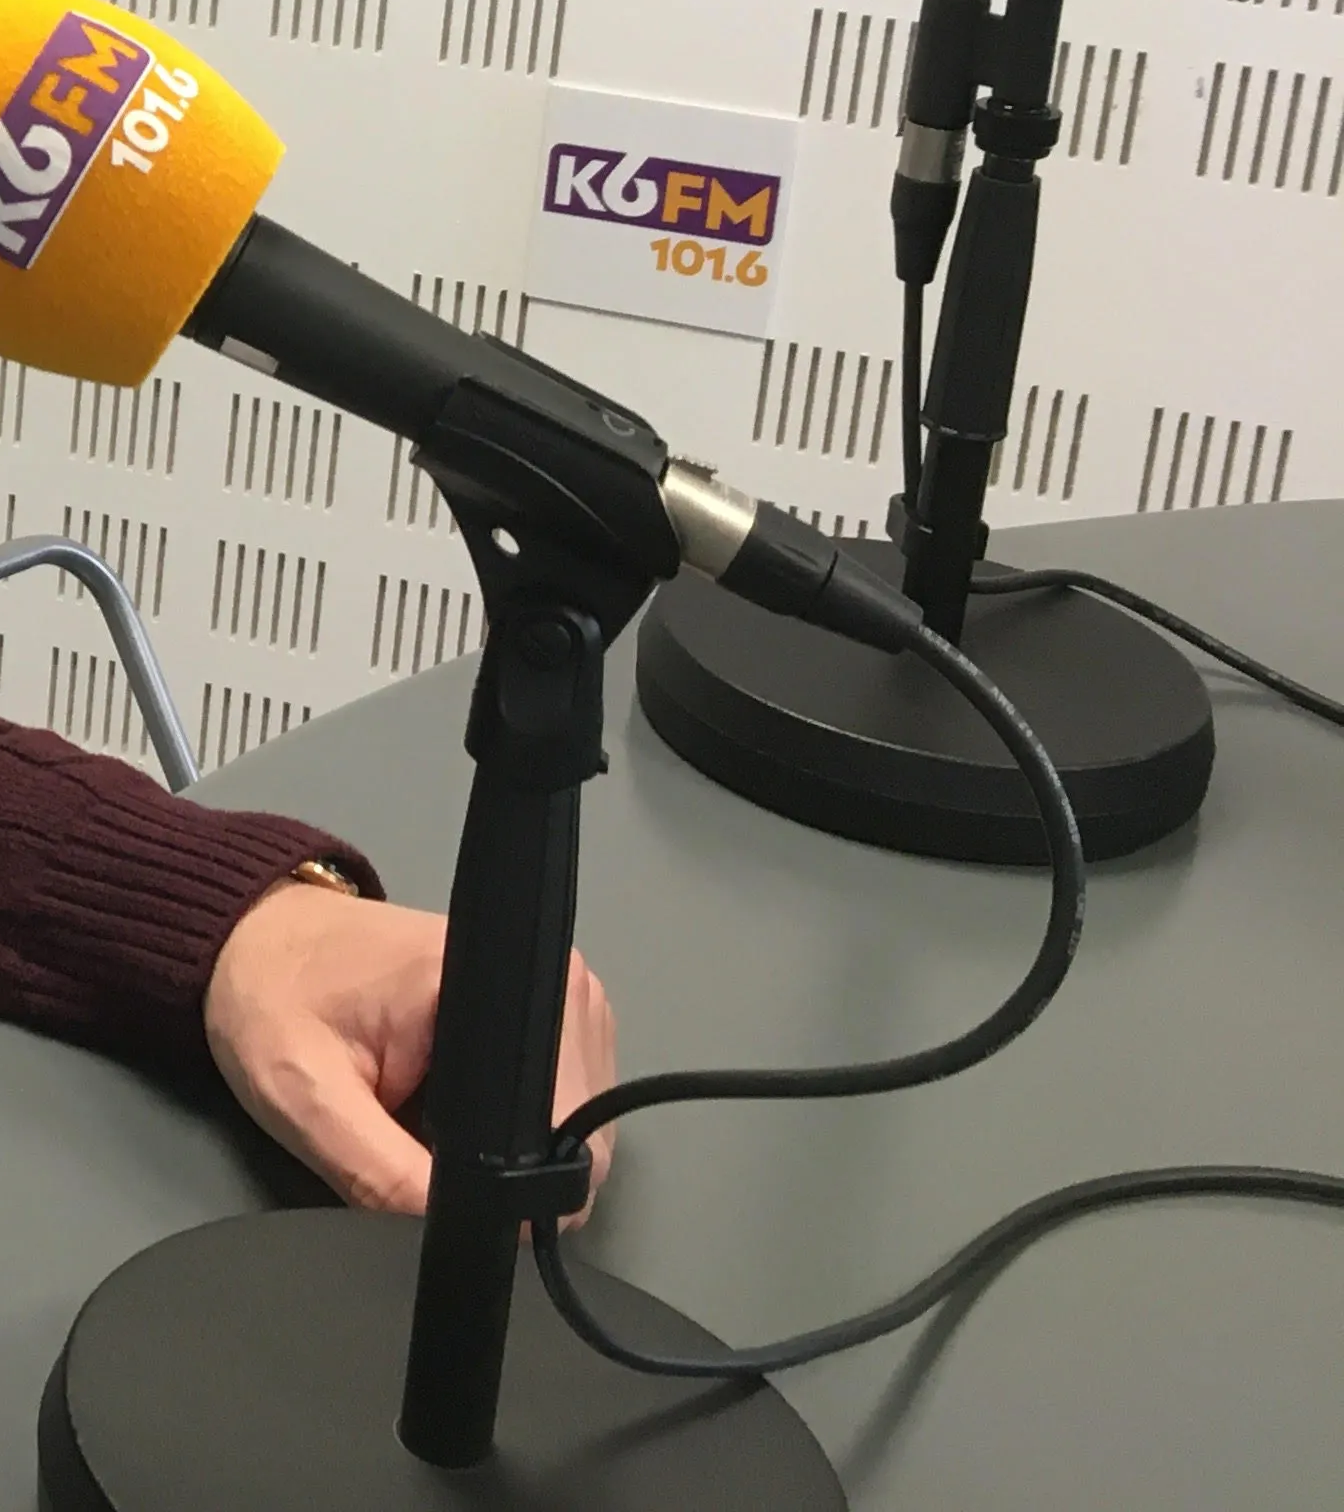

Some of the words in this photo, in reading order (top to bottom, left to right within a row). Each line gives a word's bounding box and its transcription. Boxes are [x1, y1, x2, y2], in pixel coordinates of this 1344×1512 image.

[110, 63, 201, 175] 101.6
[554, 152, 772, 238] K6FM
[650, 237, 769, 287] 101.6
